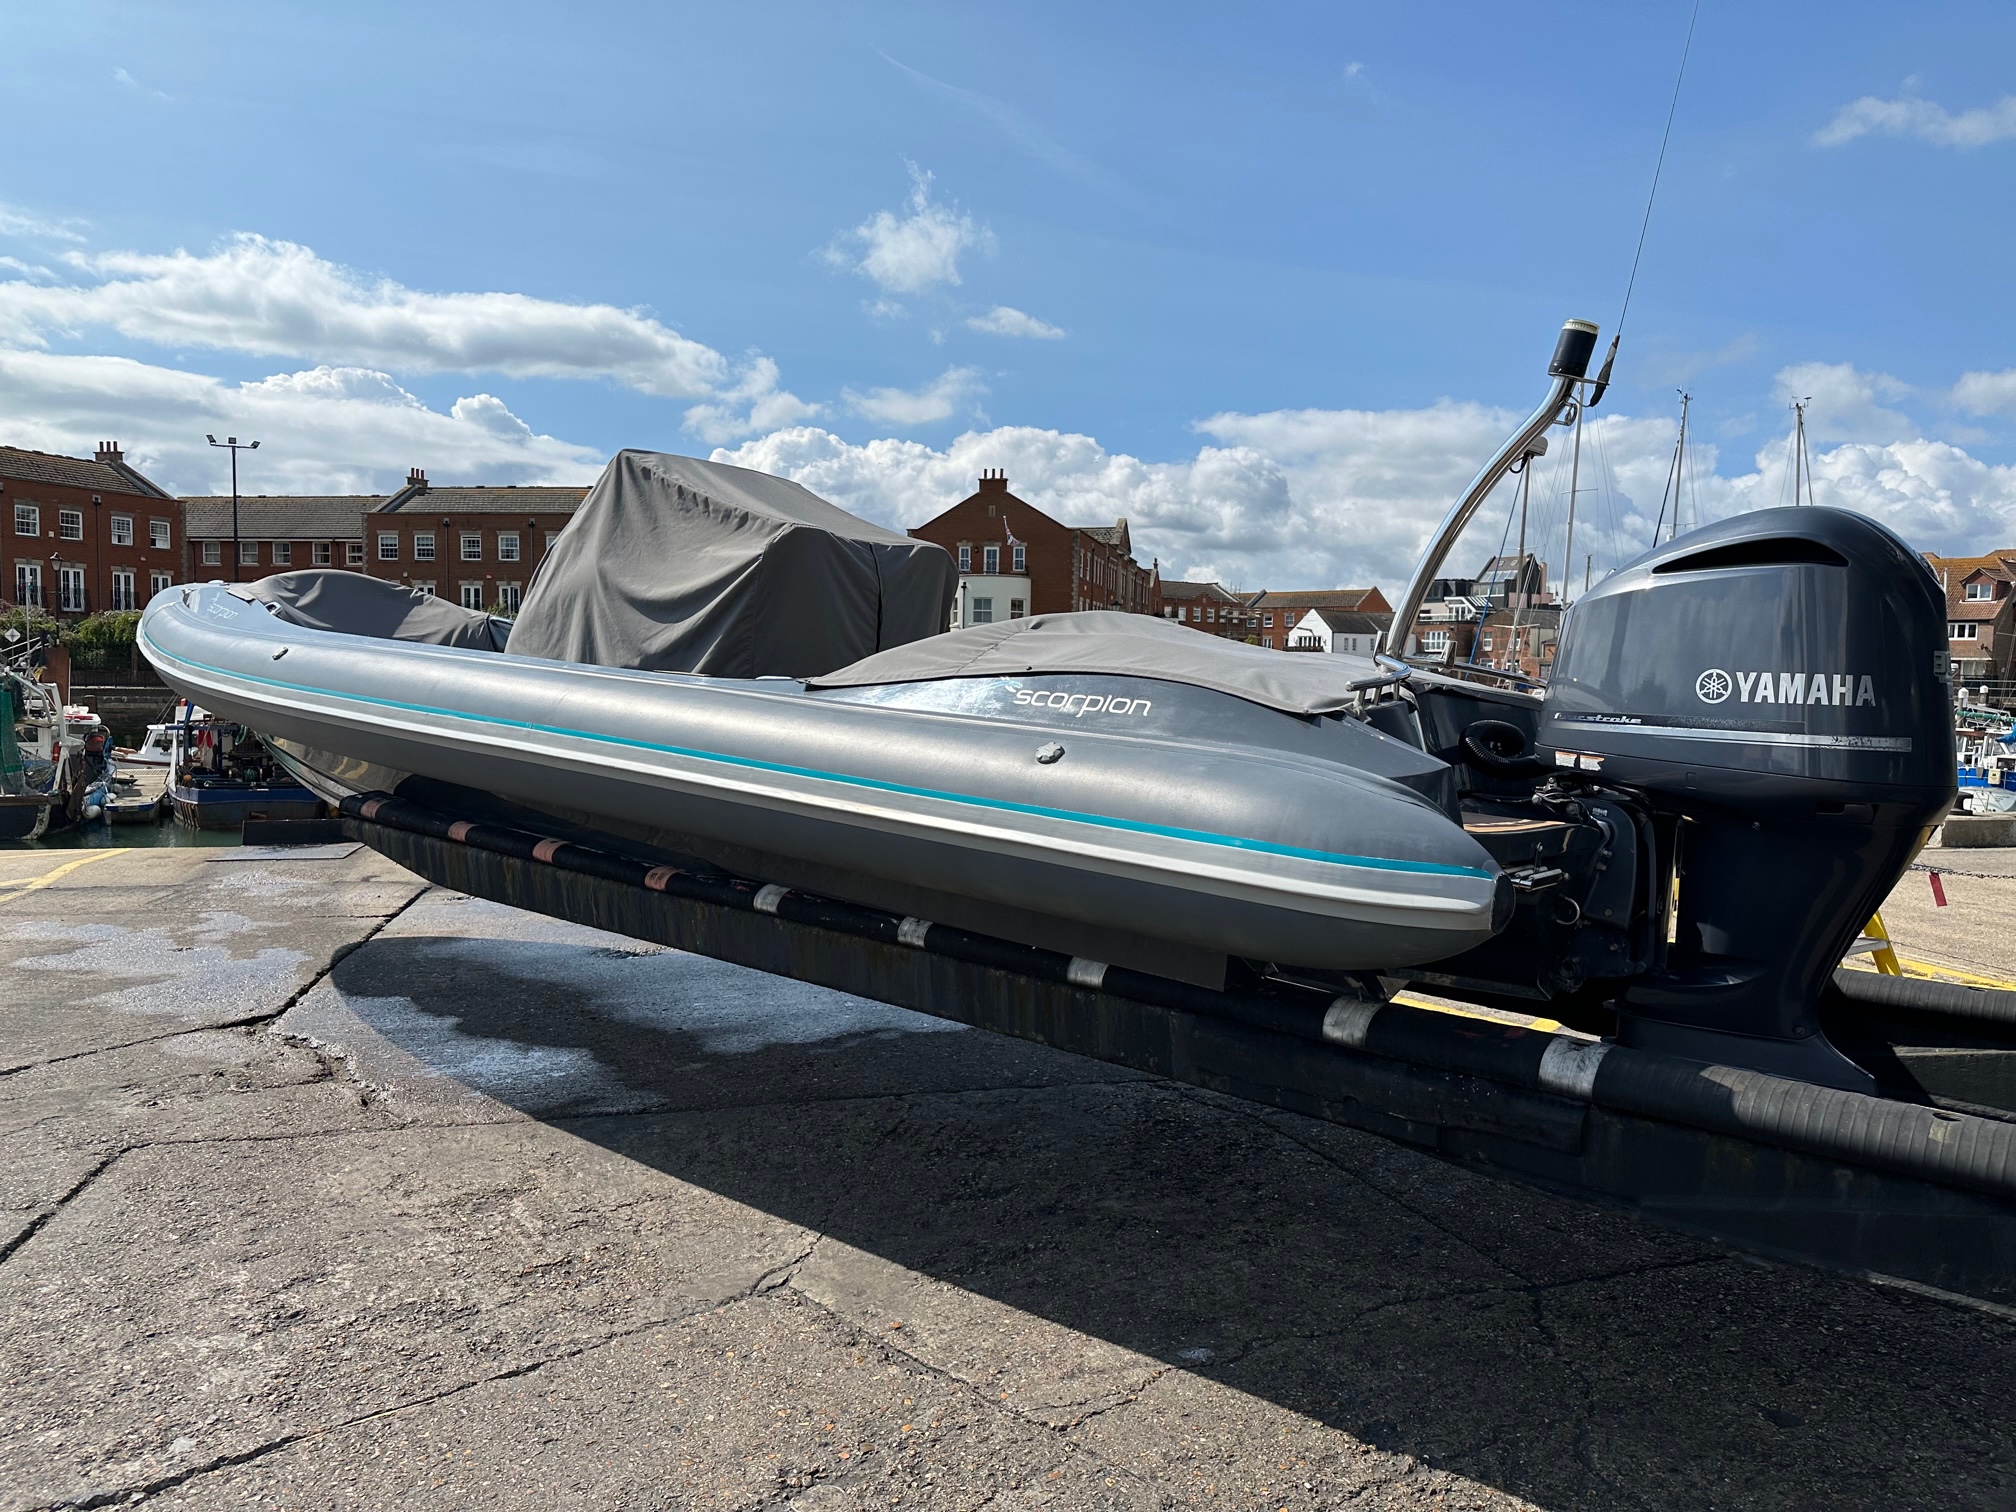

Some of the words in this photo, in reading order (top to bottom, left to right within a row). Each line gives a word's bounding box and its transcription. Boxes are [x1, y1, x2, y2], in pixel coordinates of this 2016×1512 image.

[1013, 689, 1152, 718] scorpion
[1735, 671, 1876, 707] YAMAHA
[1554, 712, 1642, 724] frstroke
